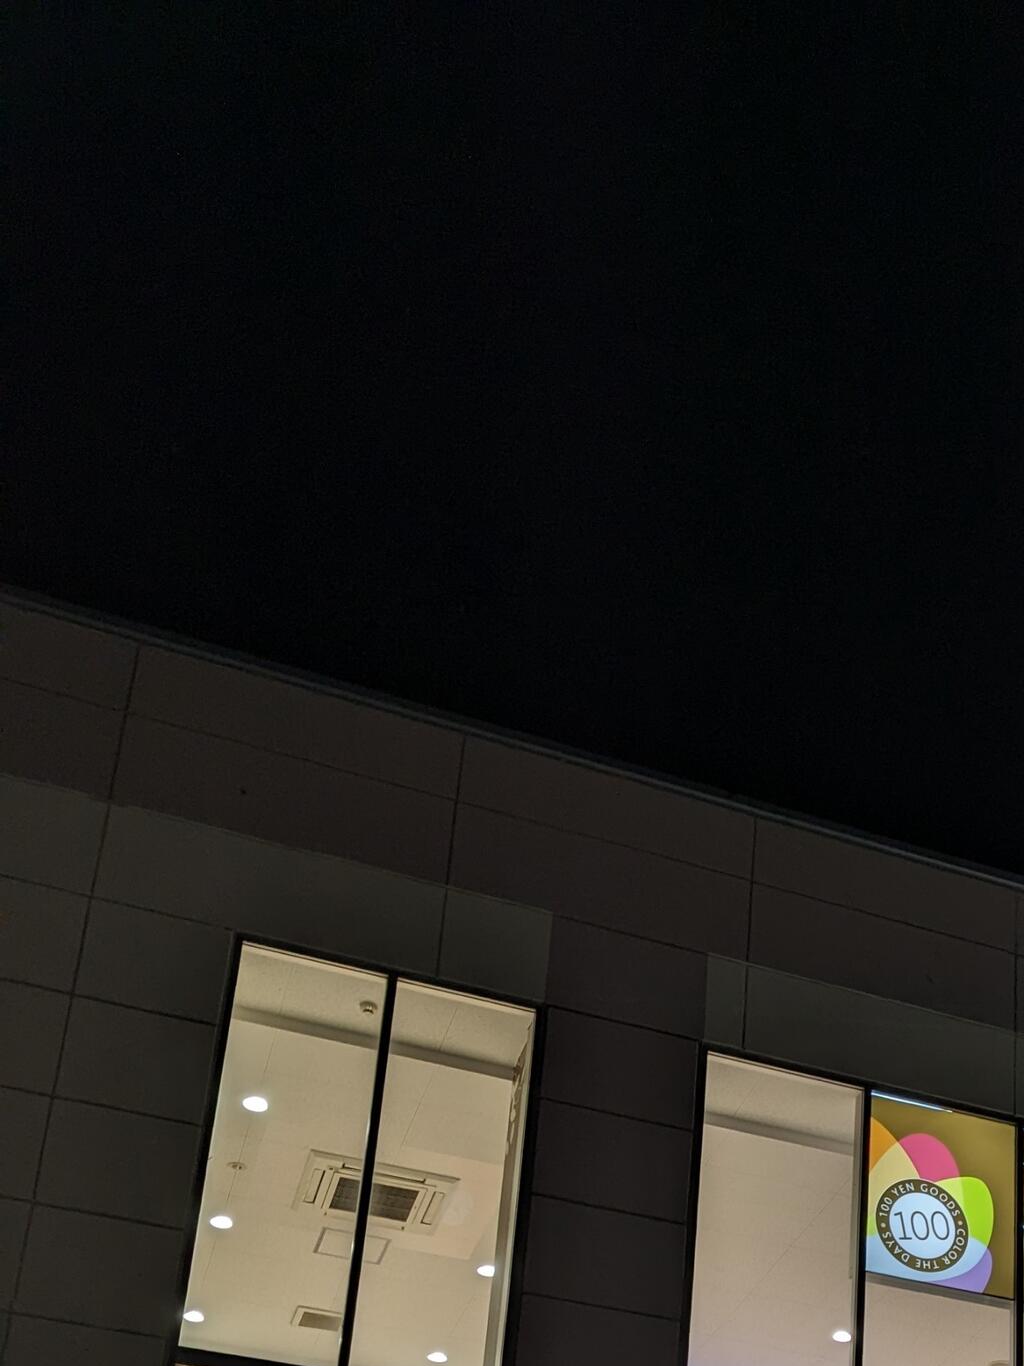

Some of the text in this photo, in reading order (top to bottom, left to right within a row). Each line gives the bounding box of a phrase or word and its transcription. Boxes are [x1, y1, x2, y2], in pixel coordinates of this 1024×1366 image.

[879, 1182, 960, 1217] 100 YEN GOODS
[893, 1210, 950, 1241] 100
[882, 1228, 966, 1270] COLOR THE DAYS
